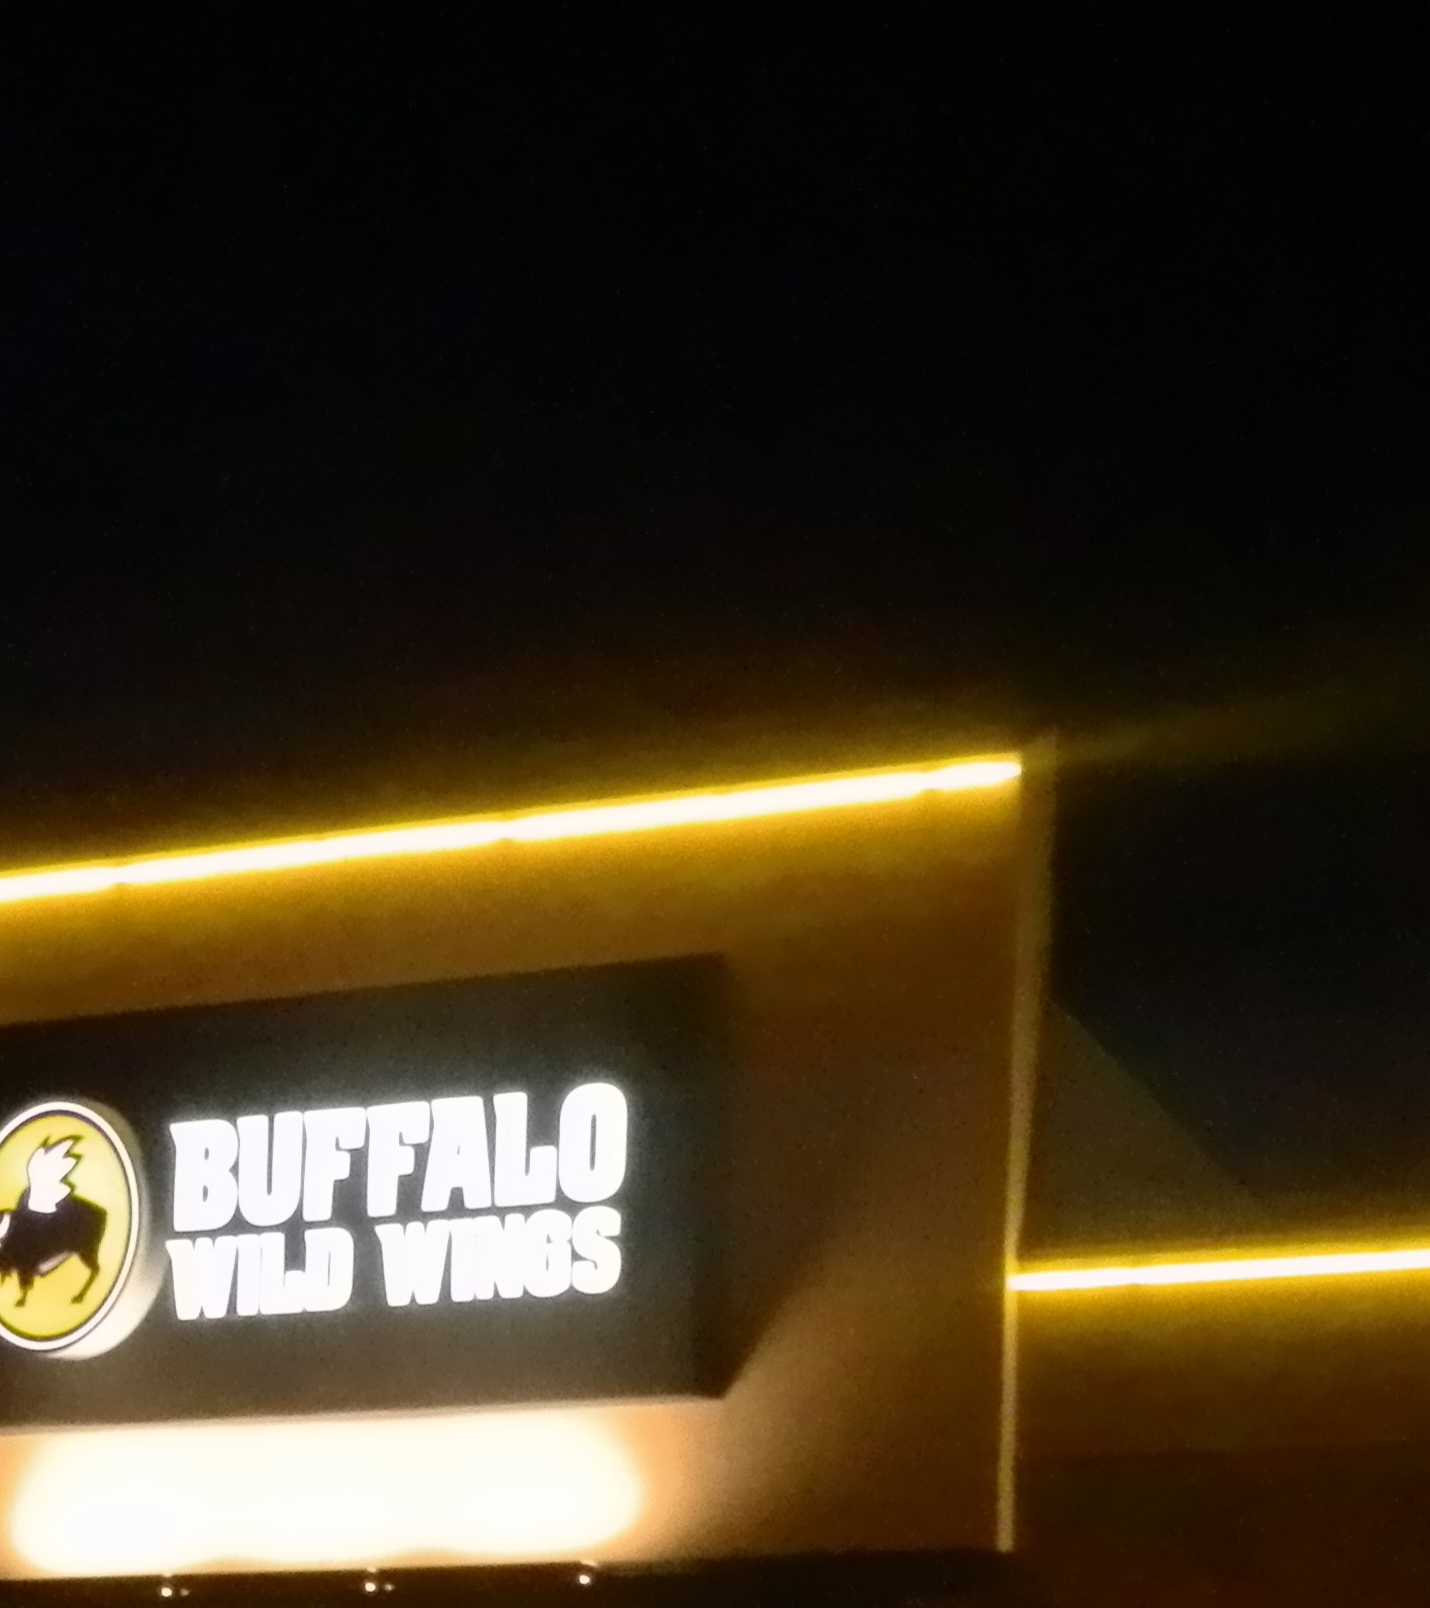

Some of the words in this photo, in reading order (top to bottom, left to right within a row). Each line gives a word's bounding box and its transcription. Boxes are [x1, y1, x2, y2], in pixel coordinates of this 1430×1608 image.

[170, 1082, 628, 1233] BUFFALO
[166, 1227, 354, 1321] WILD
[375, 1207, 623, 1308] WINGS
